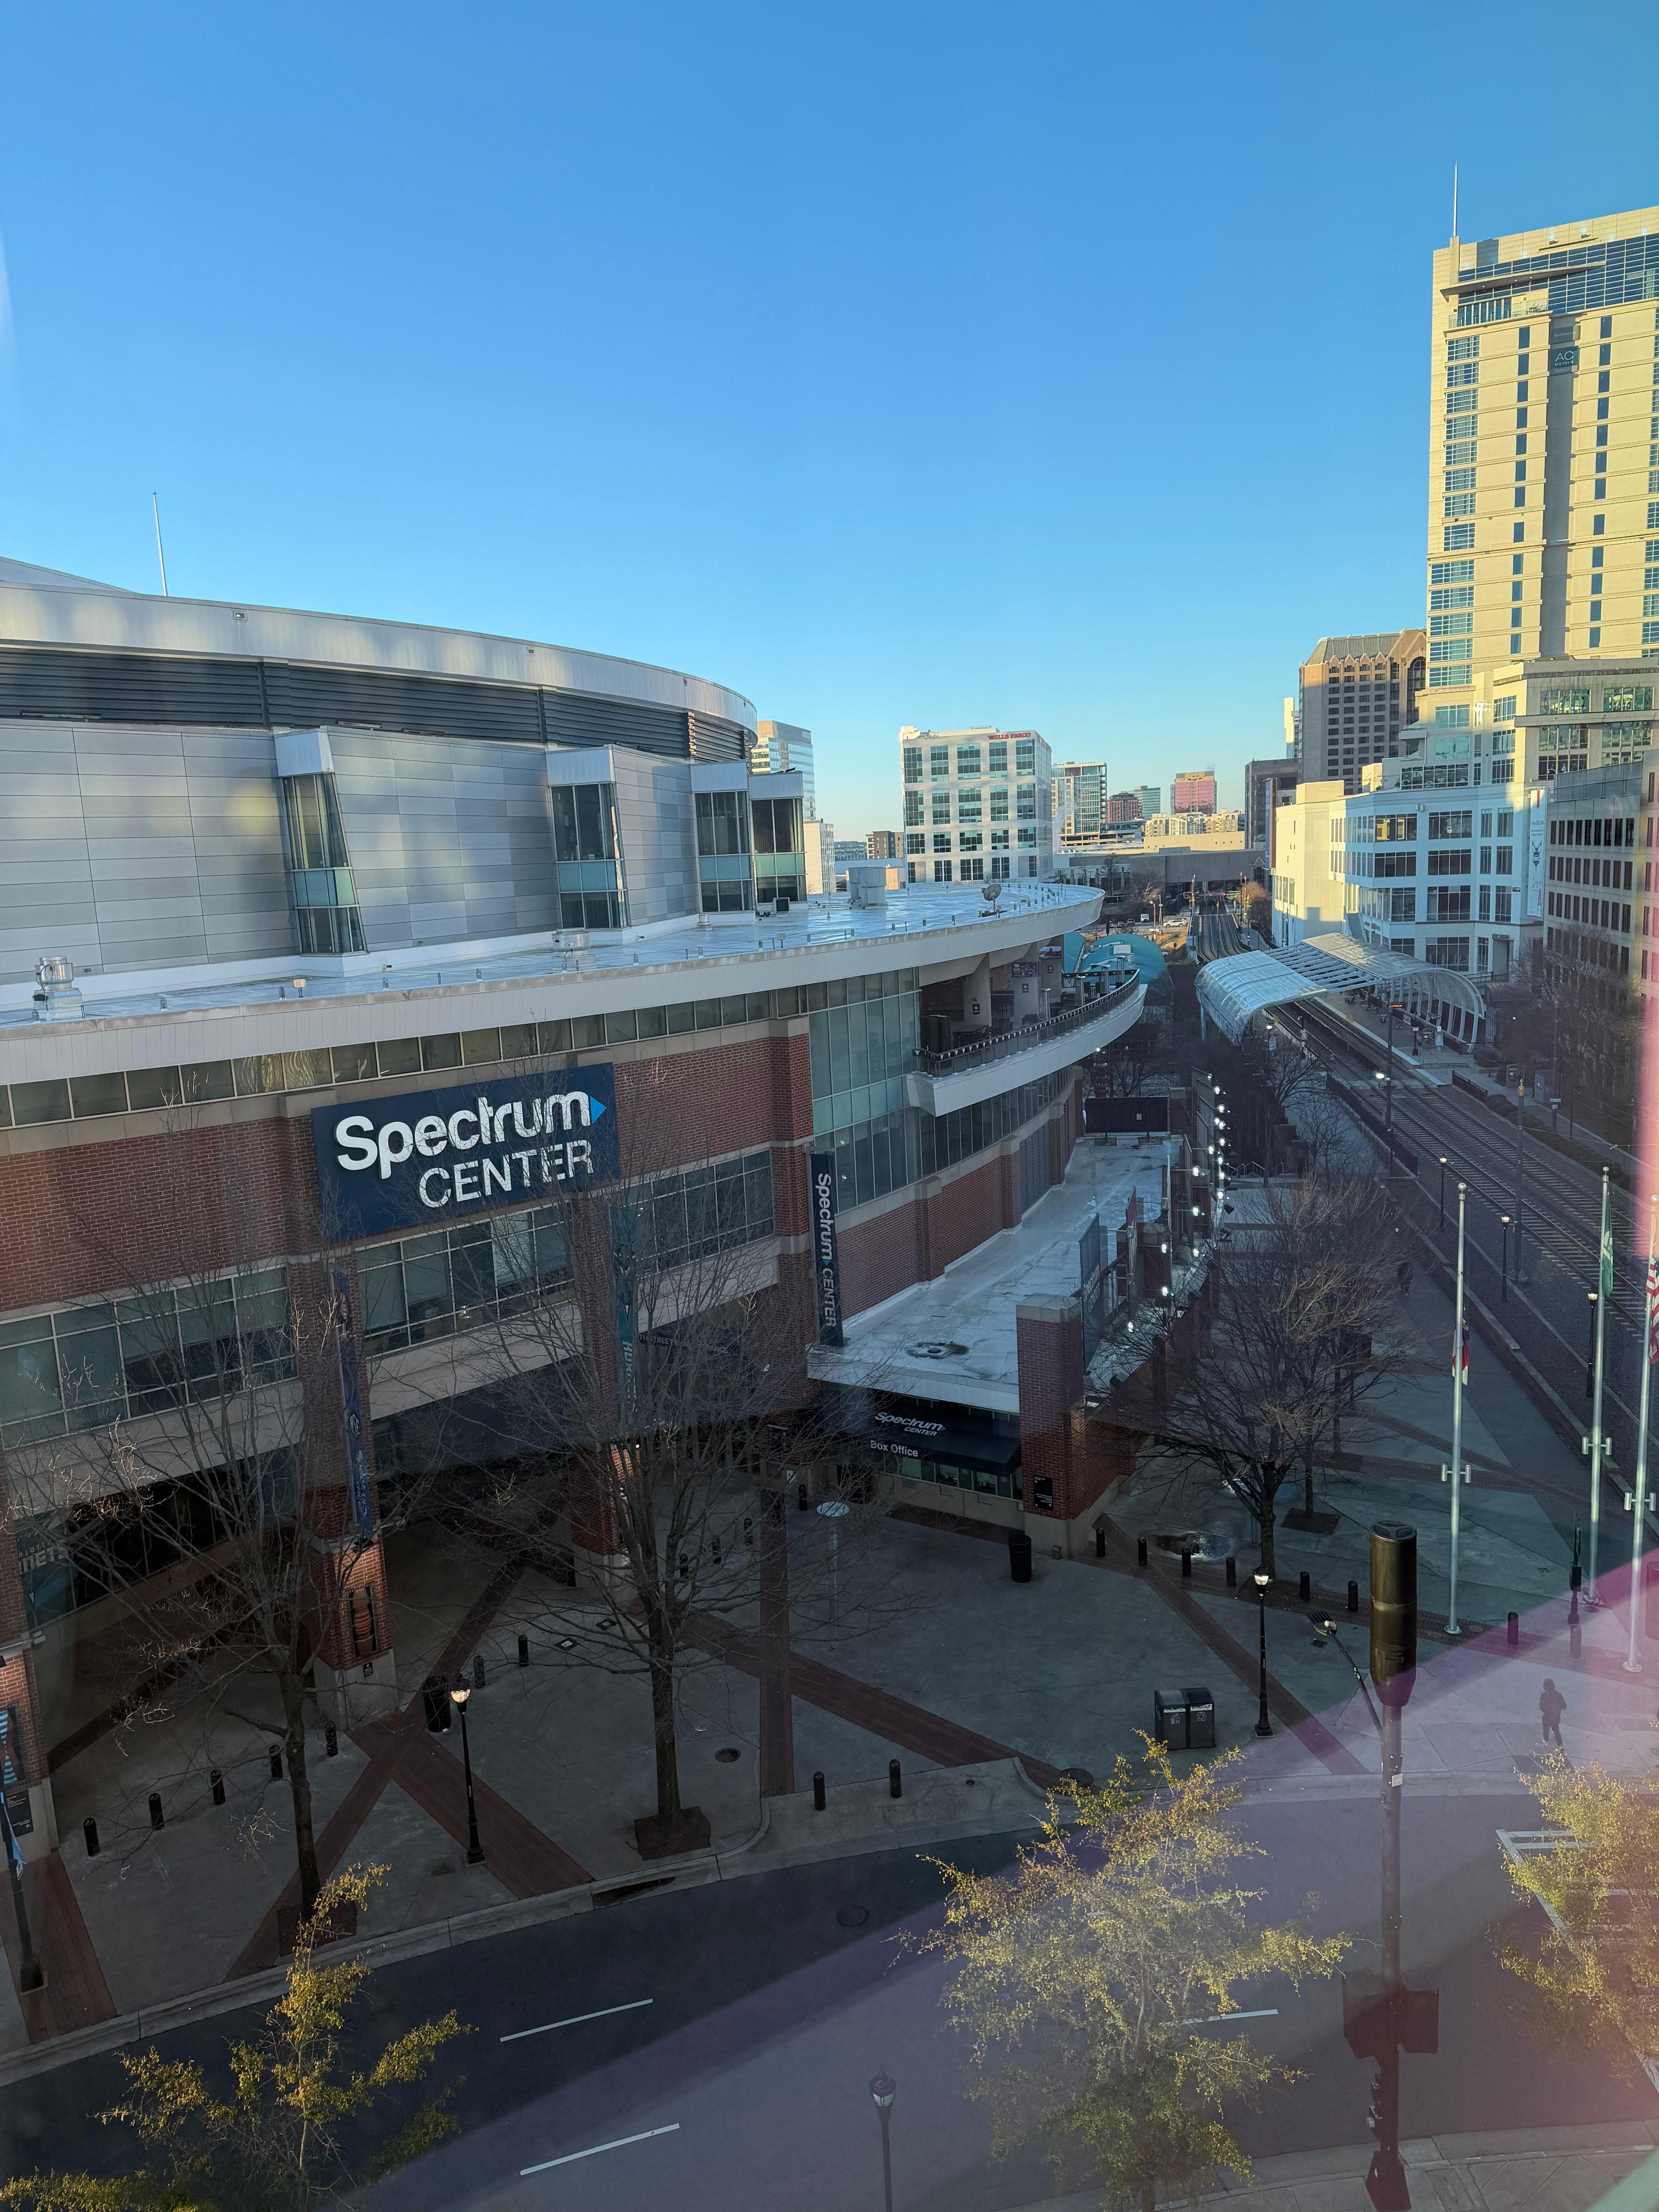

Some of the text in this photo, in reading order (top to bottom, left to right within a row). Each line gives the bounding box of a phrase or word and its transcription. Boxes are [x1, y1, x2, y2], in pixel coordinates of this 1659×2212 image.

[1555, 351, 1573, 362] AC
[336, 1091, 591, 1180] Spectrum
[419, 1140, 594, 1208] CENTER
[815, 1173, 836, 1327] Spectrum CENTER
[875, 1412, 943, 1431] Spectrum
[904, 1427, 937, 1436] CENTER
[870, 1440, 919, 1457] Box Office
